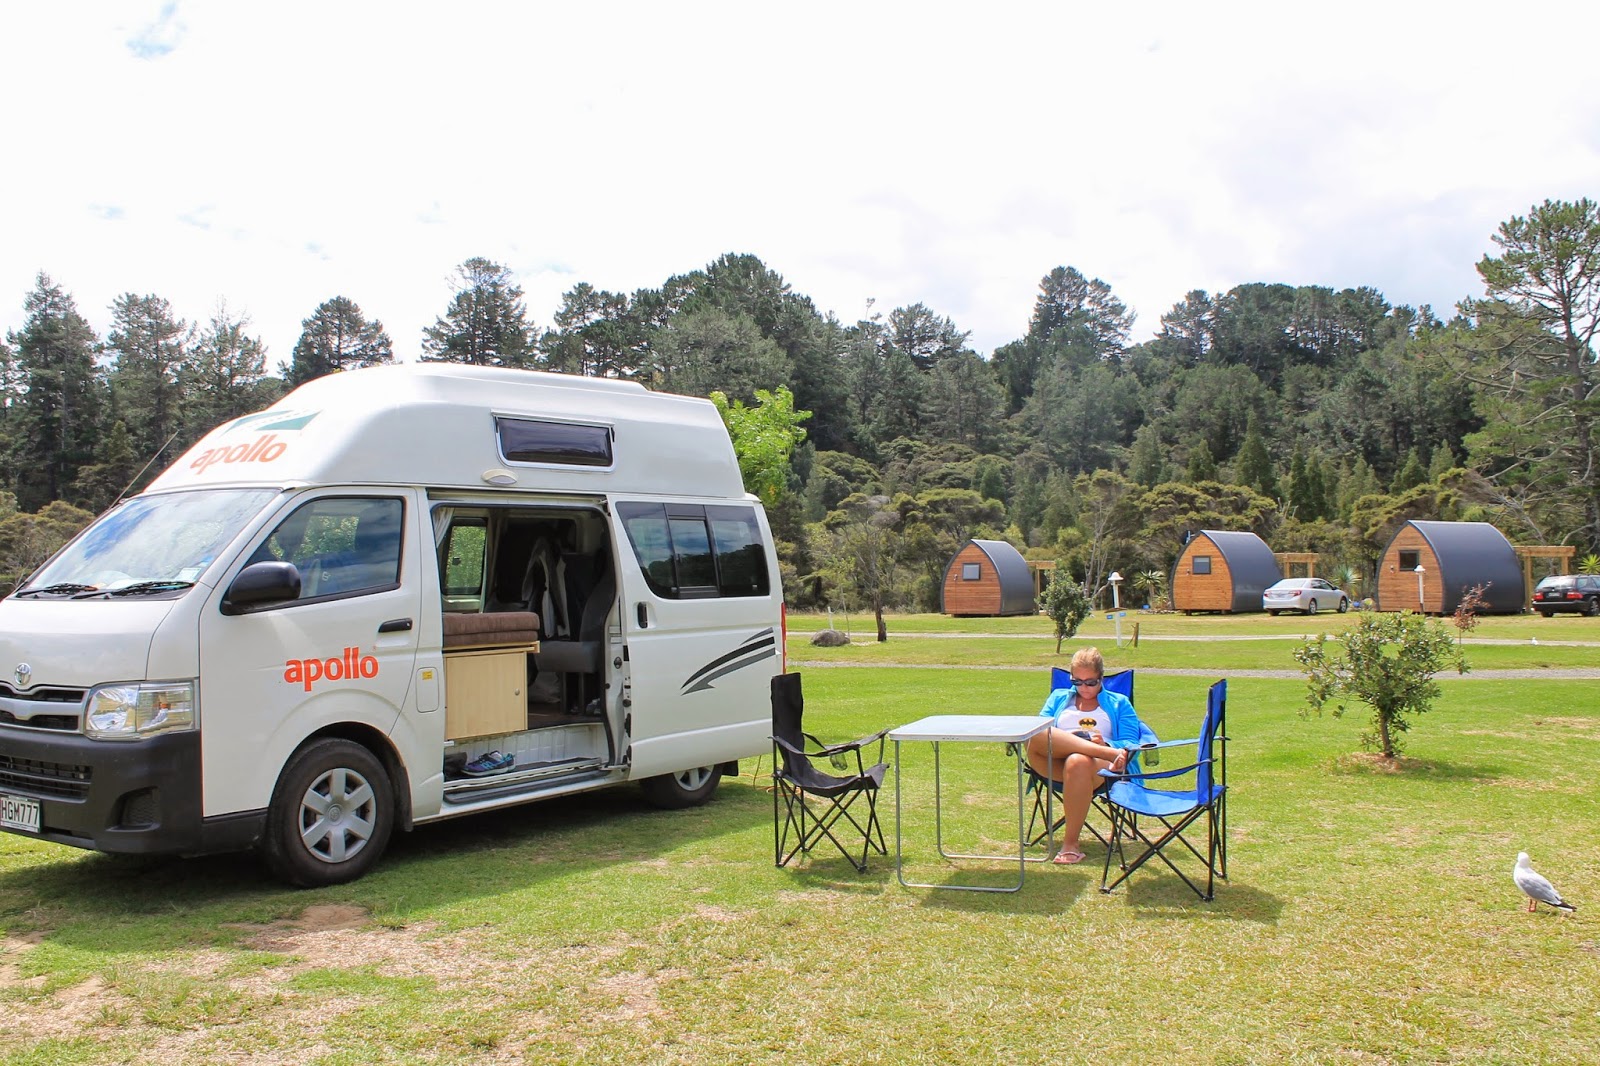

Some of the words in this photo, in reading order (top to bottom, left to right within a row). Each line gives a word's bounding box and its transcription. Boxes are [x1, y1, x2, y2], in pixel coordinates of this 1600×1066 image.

[190, 434, 287, 475] apollo
[284, 647, 378, 692] apollo
[1, 800, 38, 825] HGM777
